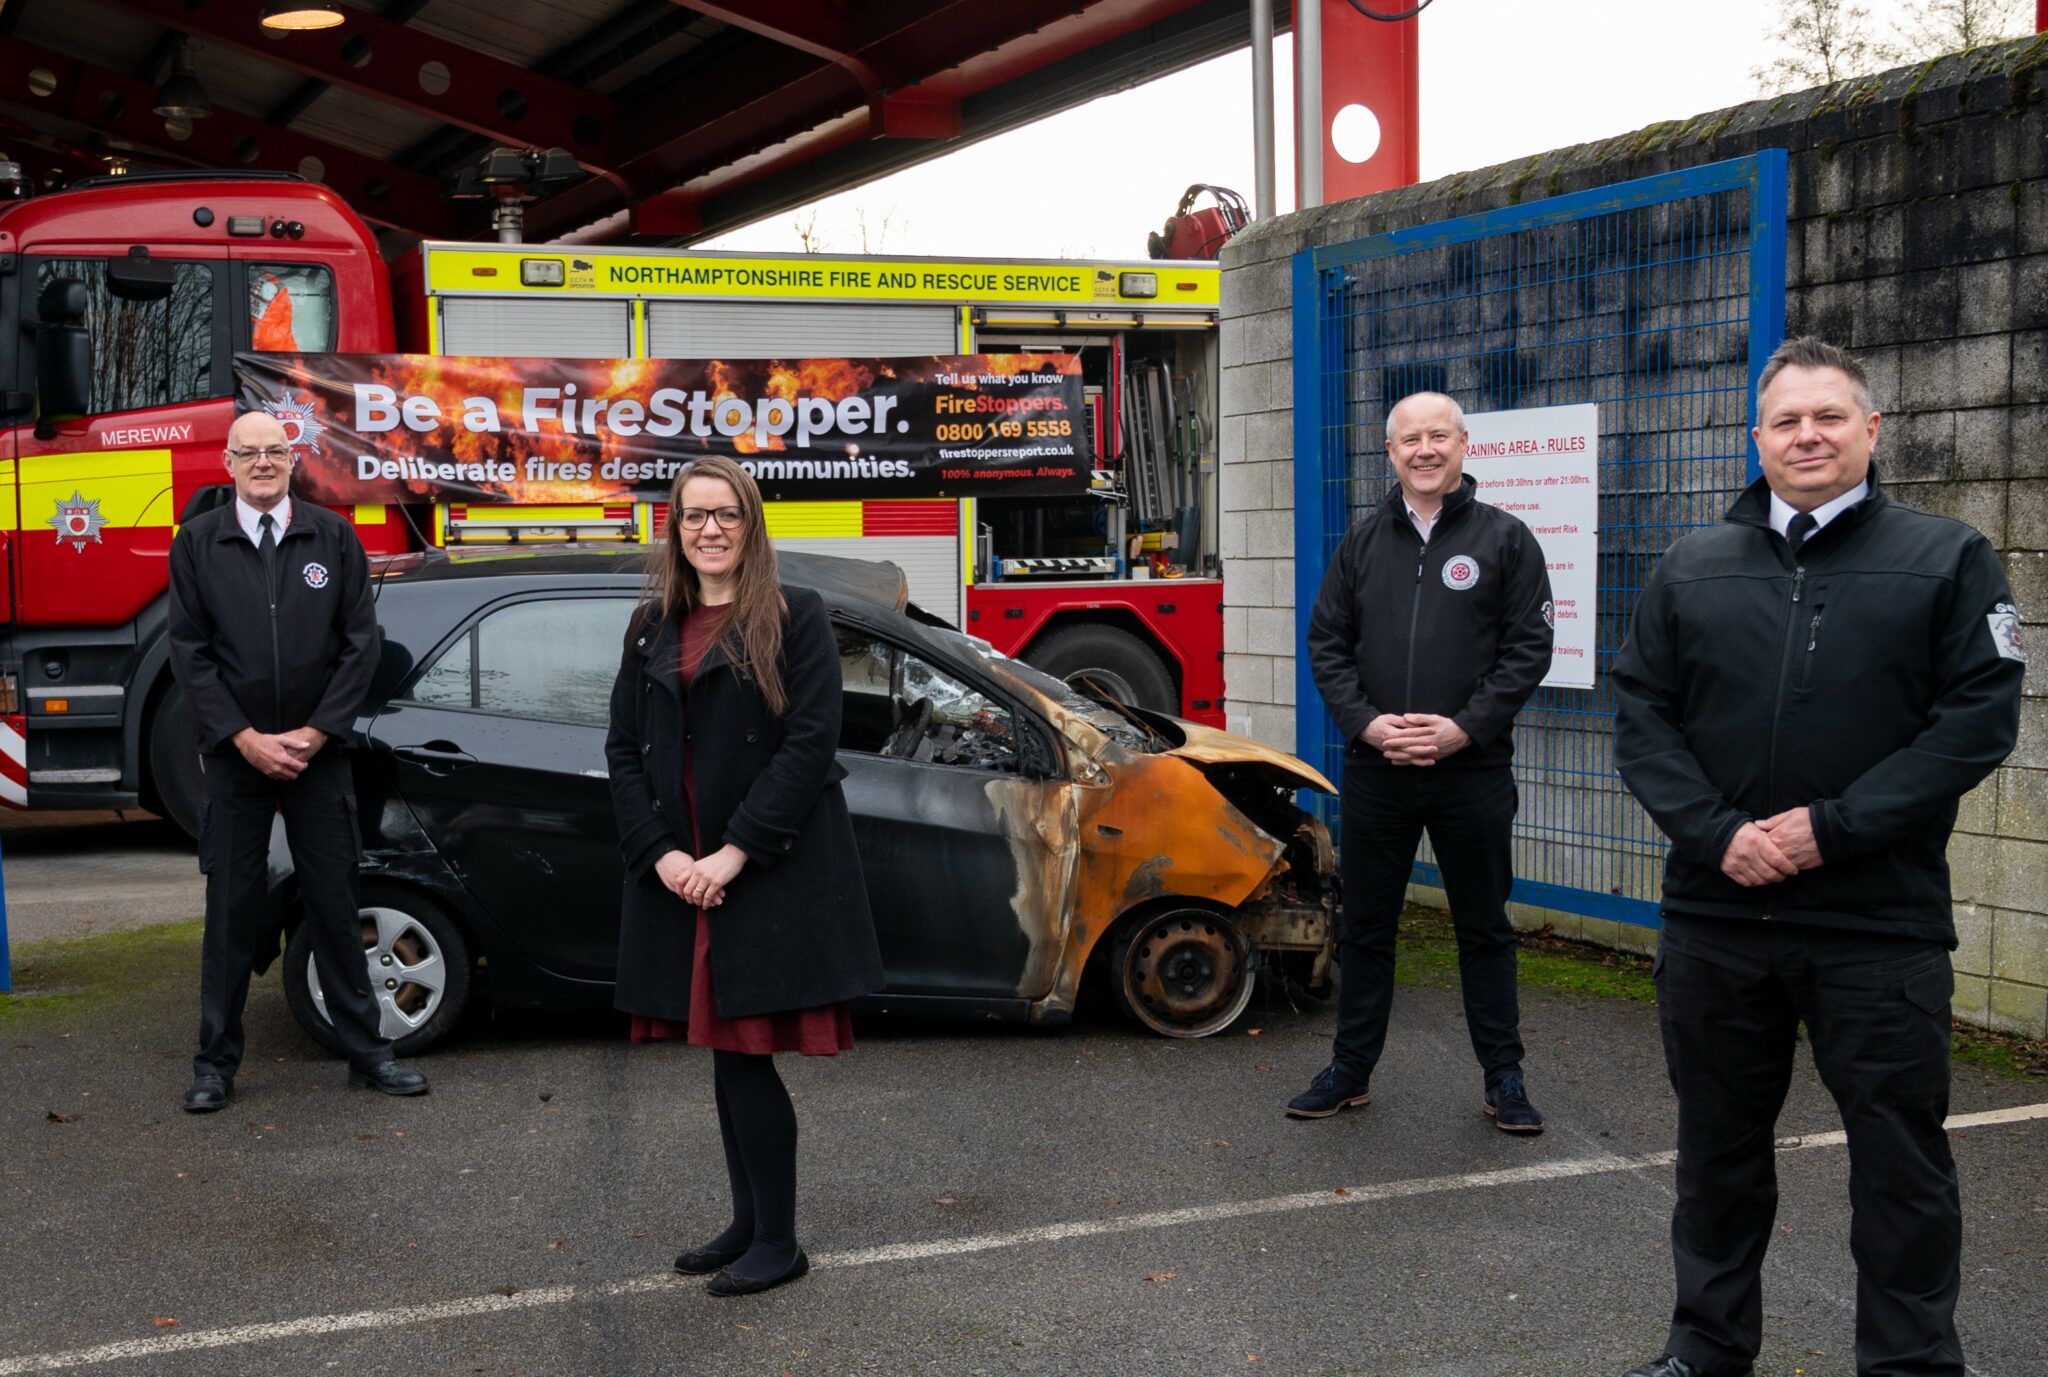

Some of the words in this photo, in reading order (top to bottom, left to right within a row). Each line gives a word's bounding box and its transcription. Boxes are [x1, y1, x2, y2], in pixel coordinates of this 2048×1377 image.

[609, 266, 824, 287] NORTHAMPTONSHIRE
[830, 271, 872, 288] FIRE
[877, 272, 917, 289] AND
[923, 273, 998, 290] RESCUE
[1003, 275, 1081, 292] SERVICE
[935, 373, 958, 385] Tell
[961, 374, 976, 385] us
[978, 373, 1006, 385] what
[1008, 374, 1029, 387] you
[1031, 372, 1064, 384] know
[935, 394, 1068, 416] FireStoppers.
[353, 383, 443, 432] Be
[463, 396, 501, 433] a
[521, 382, 910, 448] FireStopper.
[101, 424, 191, 446] MEREWAY
[935, 423, 984, 441] 0800
[988, 421, 1023, 438] 169
[1026, 419, 1072, 438] 5558
[939, 444, 1075, 459] firestoppersreport.co.uk
[1465, 442, 1505, 458] RAINING
[1508, 439, 1539, 454] AREA
[1547, 436, 1586, 452] RULES
[357, 455, 516, 482] Deliberate
[525, 456, 592, 482] fires
[601, 456, 695, 481] destr
[740, 455, 916, 479] ommunities.
[941, 469, 970, 479] 100%
[973, 467, 1034, 479] anonymous.
[1036, 466, 1076, 478] Always.
[1485, 479, 1505, 488] before
[1506, 477, 1534, 488] 09:30hrs
[1543, 475, 1559, 486] after
[1505, 502, 1526, 511] before
[1535, 525, 1562, 534] relevant
[1563, 524, 1578, 534] Risk
[1567, 561, 1575, 570] in
[1554, 599, 1576, 608] sweep
[1557, 610, 1578, 619] debris
[1558, 646, 1584, 658] training
